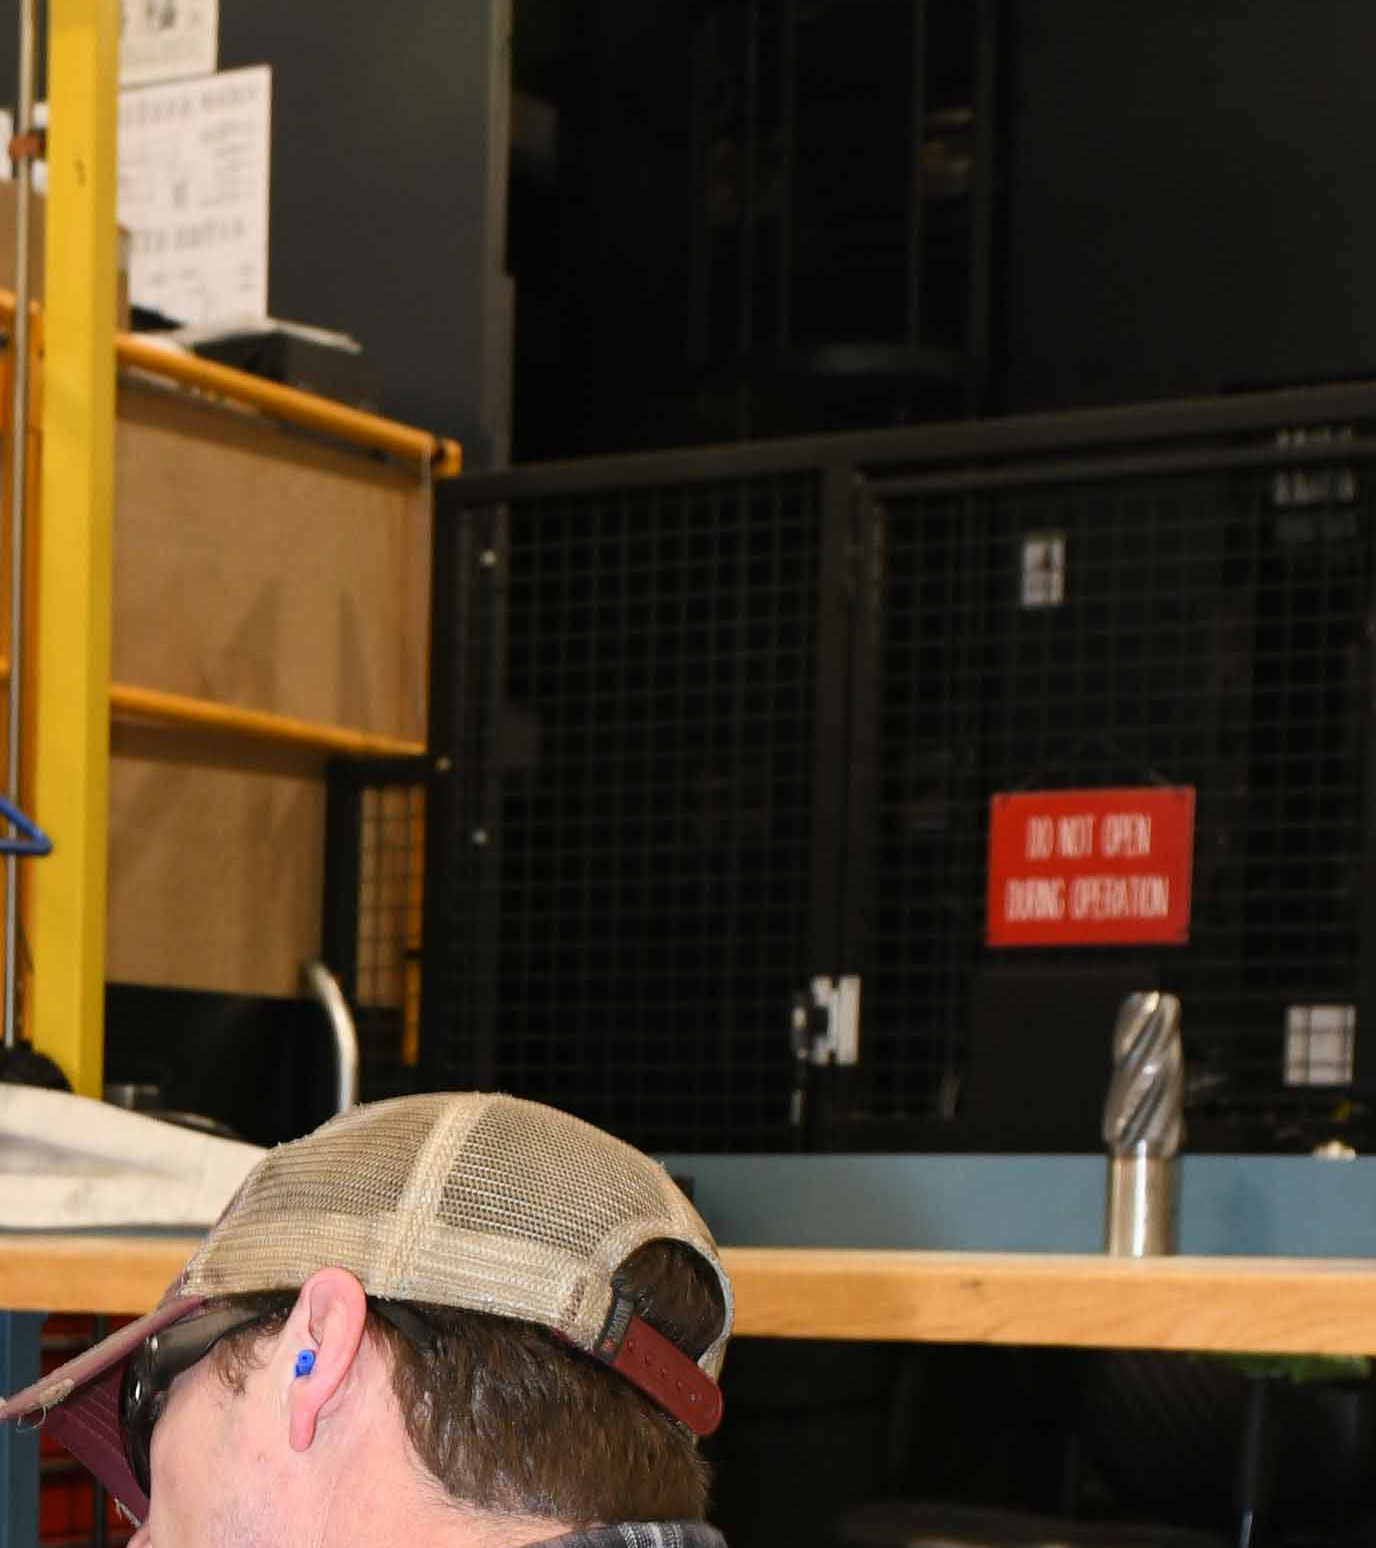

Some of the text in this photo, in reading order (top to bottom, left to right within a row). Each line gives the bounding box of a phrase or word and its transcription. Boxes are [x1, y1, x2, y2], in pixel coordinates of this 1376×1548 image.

[1025, 811, 1152, 862] DO NOT OPEN
[1004, 874, 1169, 922] DURING OPERATION
